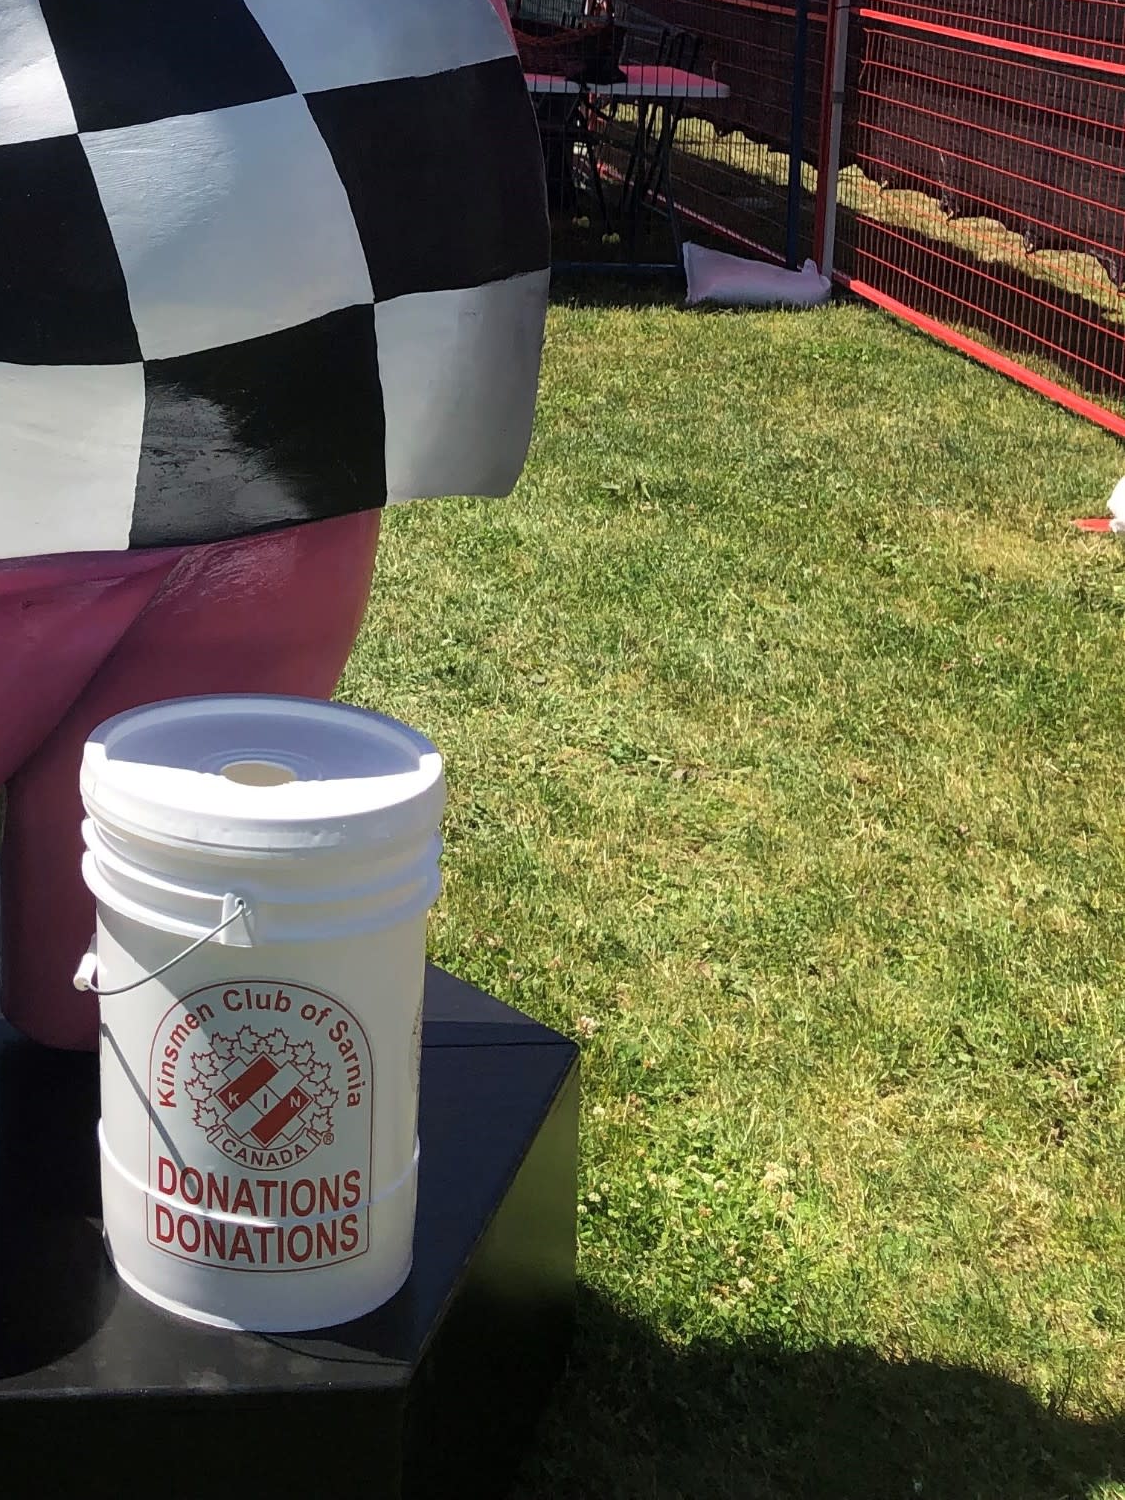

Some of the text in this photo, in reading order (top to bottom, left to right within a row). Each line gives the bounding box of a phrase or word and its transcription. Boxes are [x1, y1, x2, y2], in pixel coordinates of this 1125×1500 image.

[157, 988, 366, 1108] Kinsmen Club of Sarnia
[222, 1139, 307, 1167] CANADA
[157, 1155, 361, 1218] DONATIONS
[155, 1205, 359, 1264] DONATIONS
